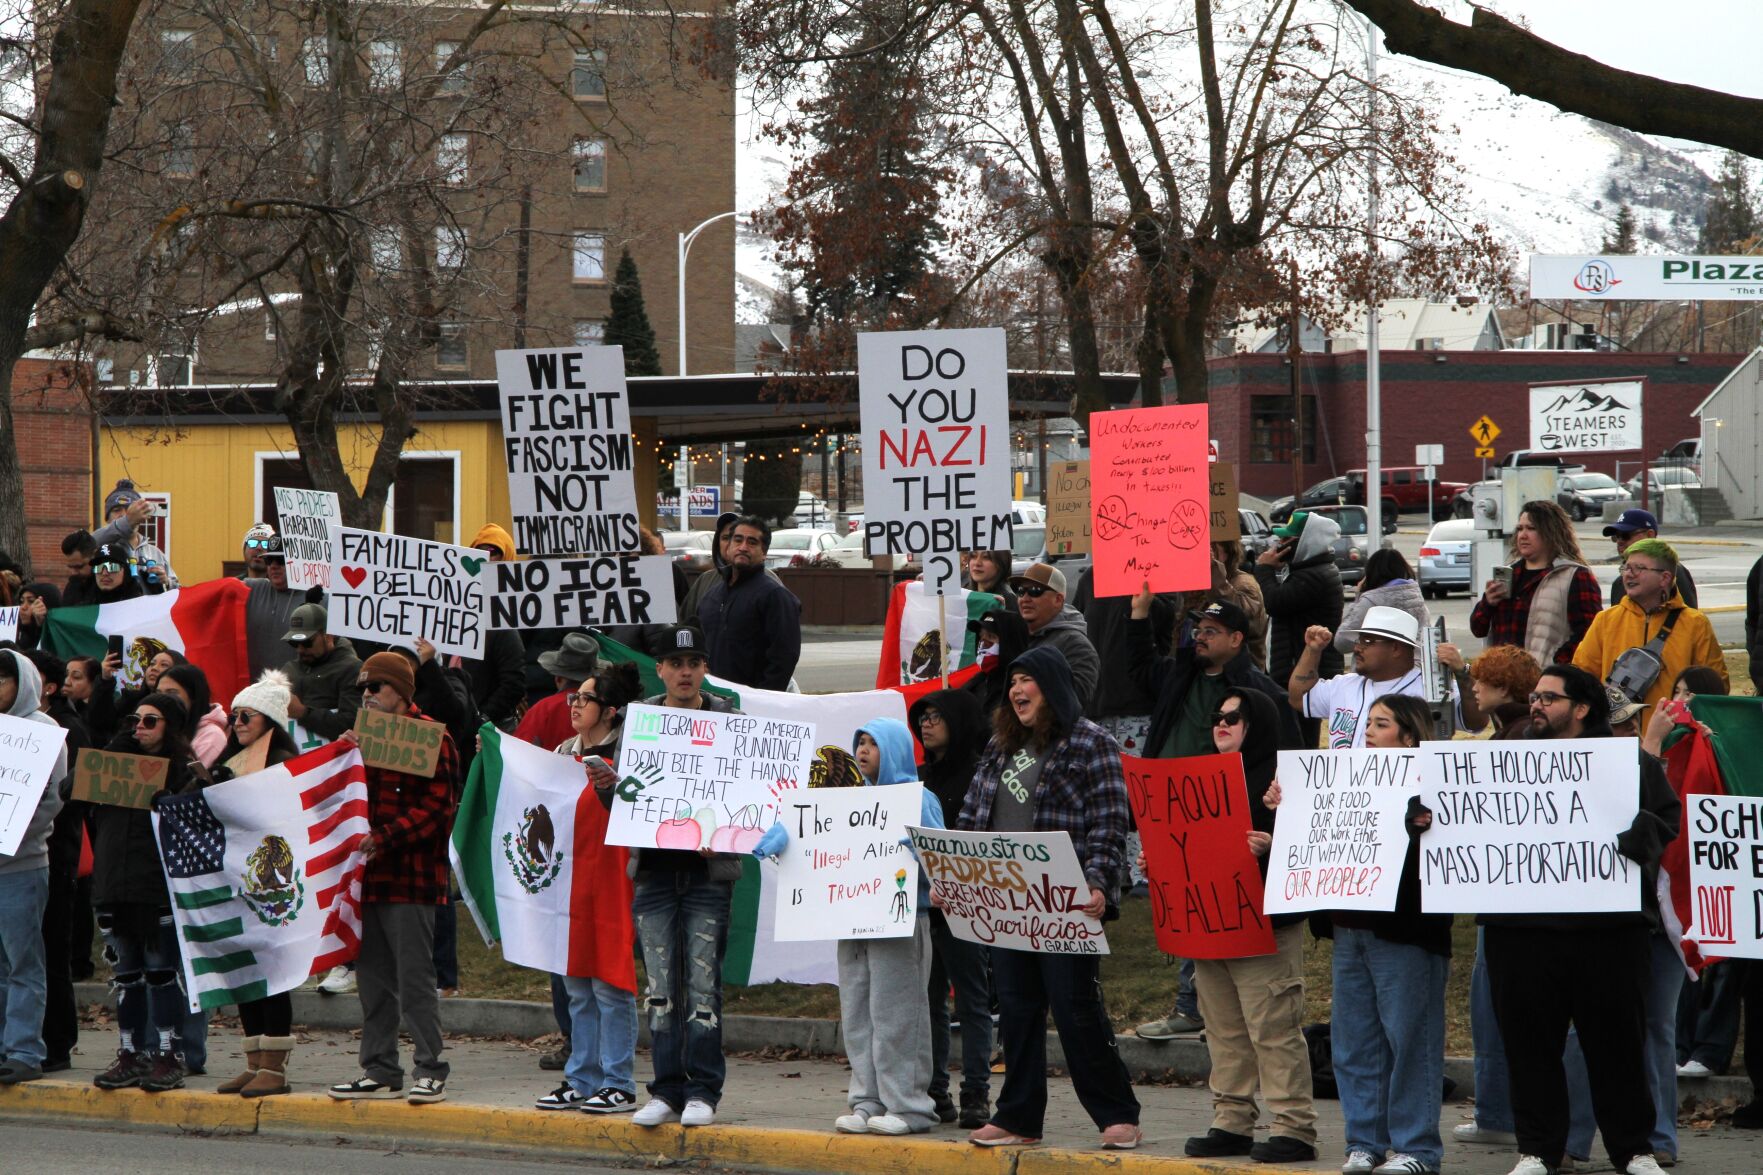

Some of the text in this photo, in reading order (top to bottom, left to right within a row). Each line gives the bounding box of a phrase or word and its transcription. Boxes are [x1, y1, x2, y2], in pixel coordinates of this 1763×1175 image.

[526, 352, 586, 390] WE
[902, 345, 965, 380] DO
[508, 392, 620, 432] FIGHT
[888, 388, 976, 423] YOU
[1097, 415, 1199, 437] Undocumented
[1546, 415, 1626, 433] STEAMERS
[1563, 433, 1608, 448] WEST
[506, 434, 631, 473] FASCISM
[879, 425, 986, 470] NAZI
[1168, 465, 1195, 474] billion
[296, 490, 334, 517] PADRES
[534, 474, 609, 512] NOT
[893, 473, 976, 511] THE
[1209, 482, 1226, 496] NCE
[280, 513, 328, 540] TRABAJAN
[513, 513, 640, 555] IMMIGRANTS
[865, 513, 1014, 555] PROBLEM
[1209, 511, 1227, 527] NTS
[283, 538, 299, 559] MAS
[300, 538, 323, 561] DURO
[341, 534, 457, 577] FAMILIES
[1131, 535, 1150, 547] Tu
[497, 556, 642, 593] NO ICE
[929, 556, 953, 595] ?
[1124, 557, 1160, 577] Maga
[374, 571, 483, 613] BELONG
[490, 589, 651, 628] NO FEAR
[0, 607, 19, 626] AN
[332, 593, 479, 650] TOGETHER
[632, 710, 811, 740] IMMIGRANTS KEEP AMERICA
[734, 735, 802, 762] RUNNING!
[1012, 748, 1036, 772] adi
[671, 753, 704, 775] BITE
[714, 757, 743, 778] THE
[751, 763, 800, 784] HANDS
[1299, 754, 1415, 789] YOU WANT
[1434, 750, 1593, 785] THE HOLOCAUST
[677, 777, 733, 802] THAT
[1001, 769, 1029, 803] das
[1129, 769, 1232, 824] DE AQUÍ
[1314, 791, 1371, 810] OUR FOOD
[630, 794, 692, 827] FEED
[793, 802, 888, 838] The only
[1311, 811, 1380, 829] OUR CULTURE
[1438, 790, 1588, 825] STARTED AS A
[949, 834, 1051, 862] nuestros
[1308, 828, 1328, 844] OUR
[921, 851, 1028, 893] PADRES
[1170, 832, 1191, 882] Y
[1288, 843, 1382, 869] BUT WHY NOT
[1426, 841, 1629, 886] MASS DEPORTATION
[1694, 841, 1739, 870] FOR
[828, 878, 882, 904] TRUMP
[933, 878, 1007, 911] SEREMOS
[1032, 873, 1090, 914] VOZ
[1151, 872, 1263, 933] DE ALLÁ
[1285, 870, 1312, 901] OUR
[971, 905, 1103, 950] Sacrificios
[1698, 885, 1735, 941] NOT
